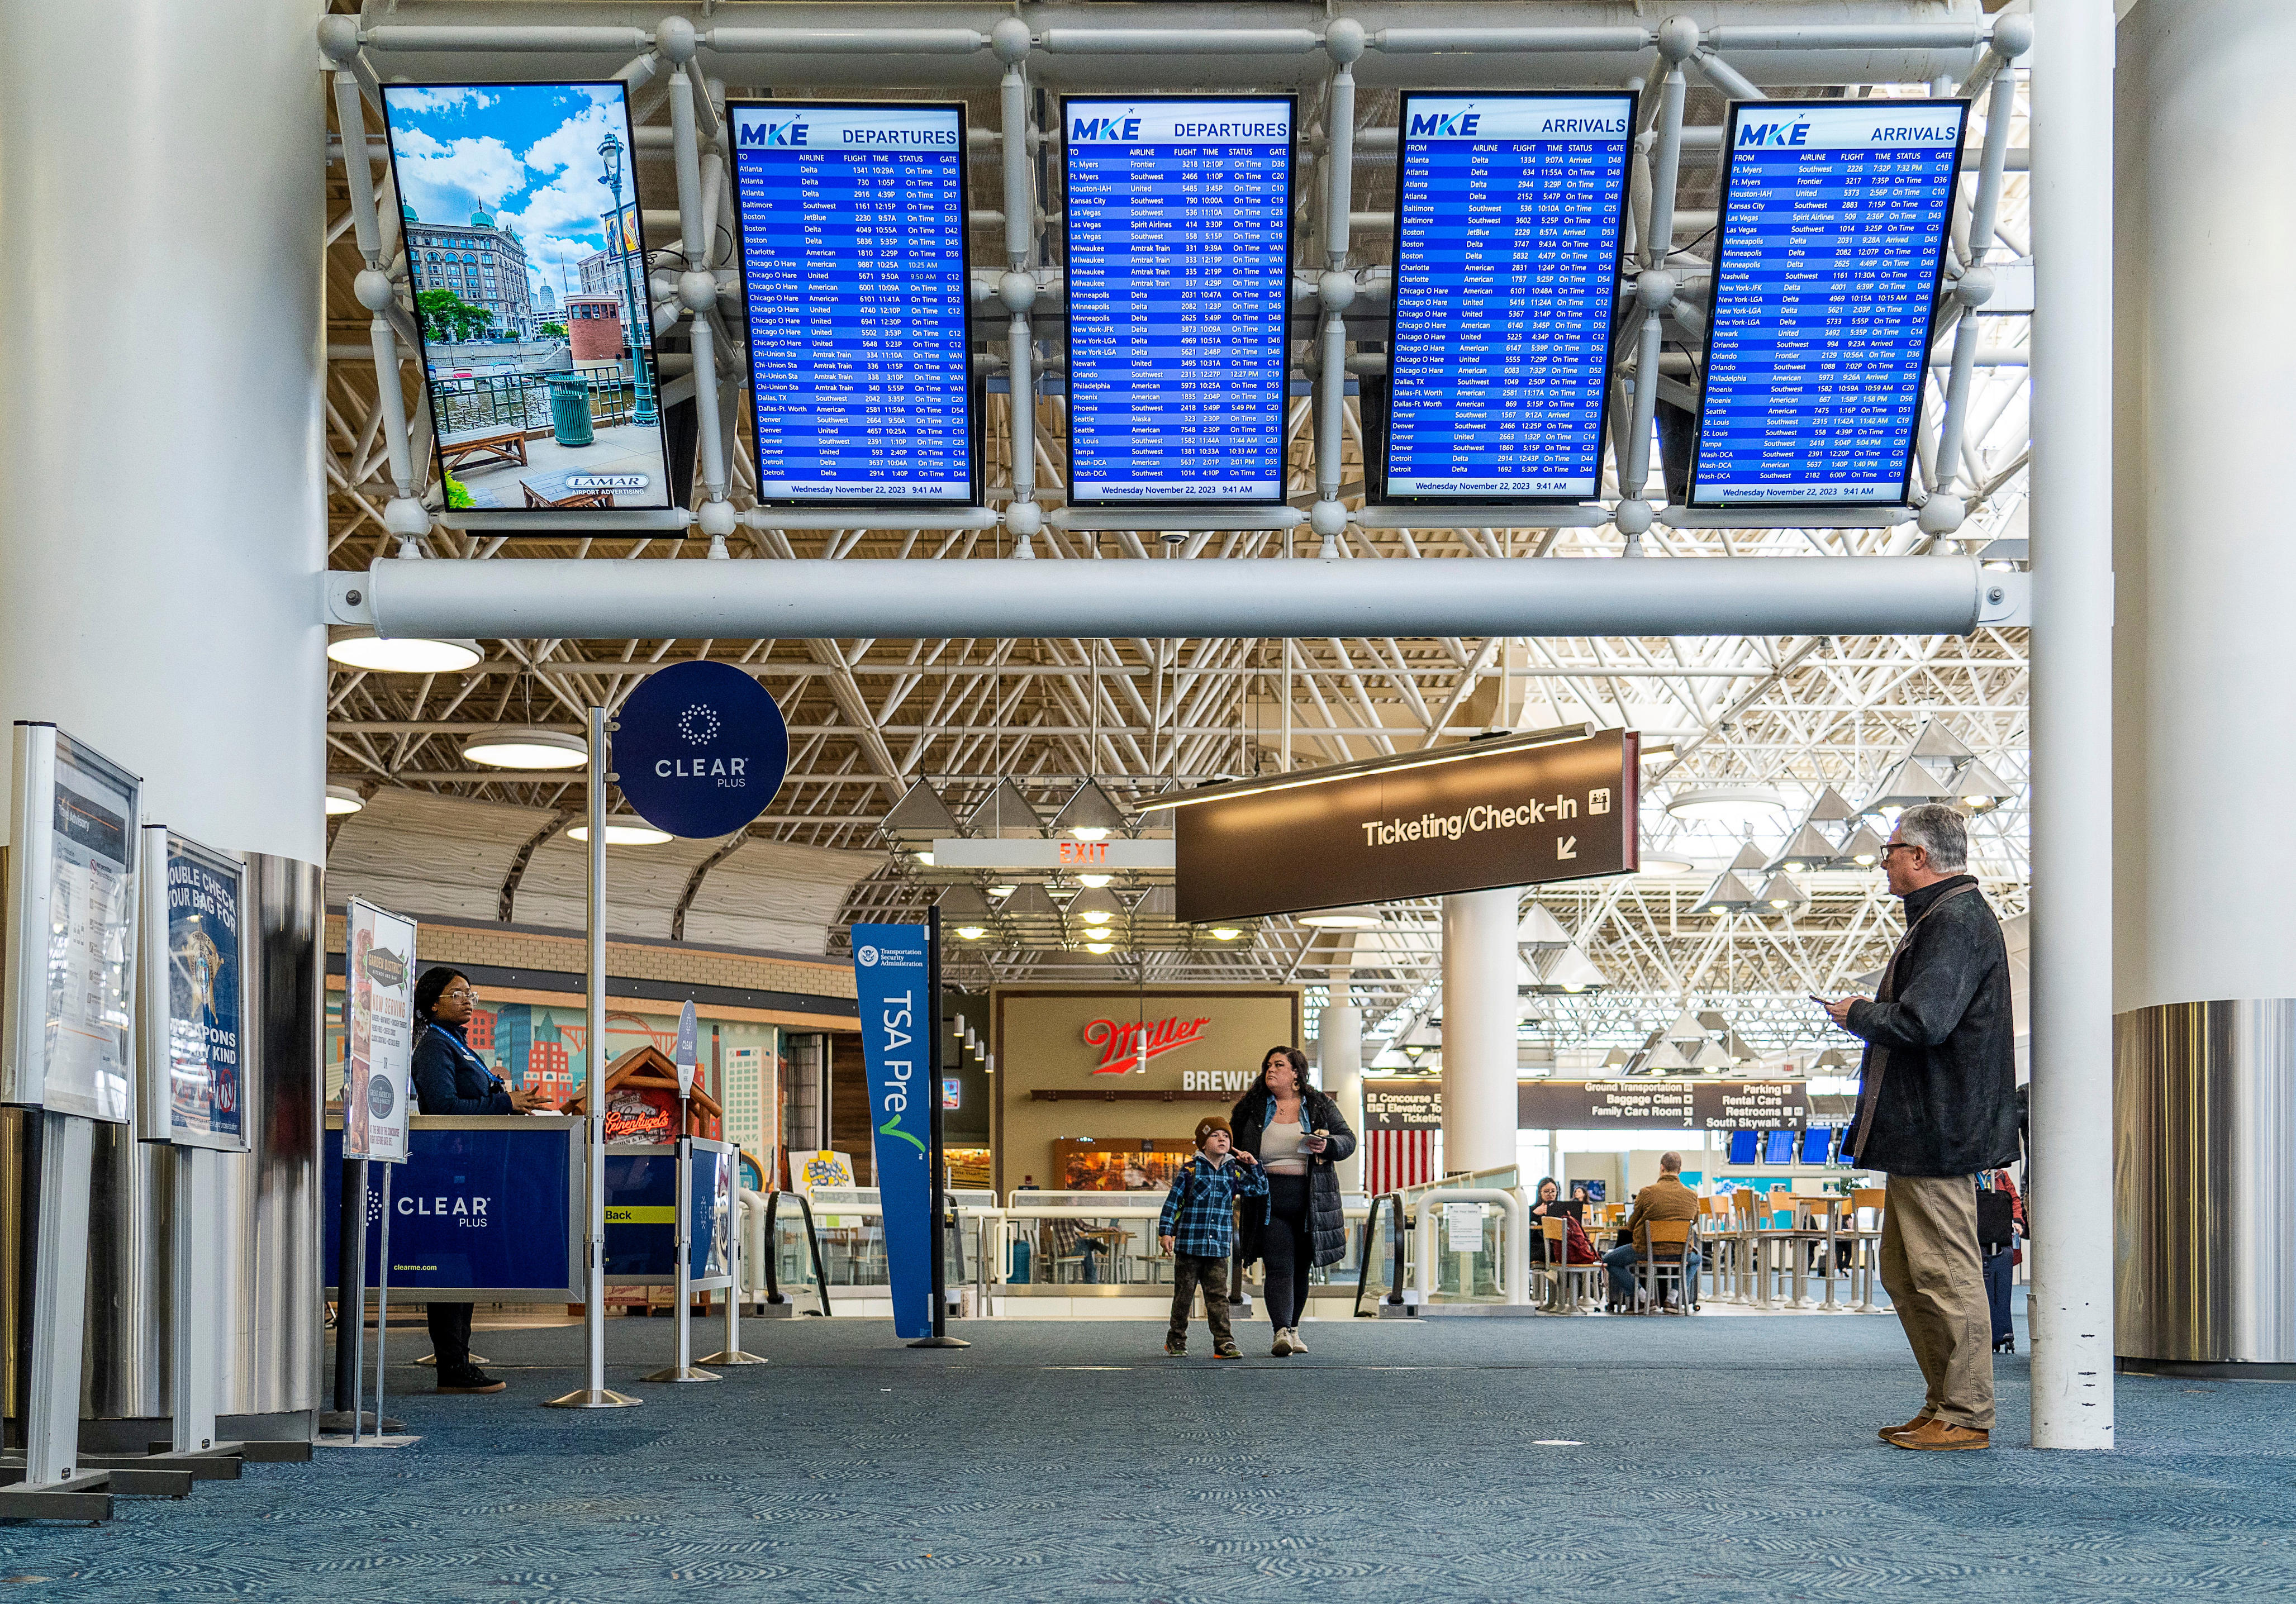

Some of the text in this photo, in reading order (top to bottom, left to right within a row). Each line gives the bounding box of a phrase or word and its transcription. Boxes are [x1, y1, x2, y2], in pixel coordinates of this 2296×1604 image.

[1072, 118, 1141, 140] MKE
[1175, 123, 1286, 136] DEPARTURES
[1410, 114, 1480, 136] MKE
[1542, 119, 1625, 132] ARRIVALS
[740, 123, 809, 145] MKE
[843, 130, 956, 144] DEPARTURES
[1739, 124, 1810, 145] MKE
[1871, 127, 1955, 140] ARRIVALS
[791, 486, 833, 495] Wednesday
[876, 486, 886, 494] 22,
[1102, 486, 1143, 495] Wednesday
[1186, 486, 1196, 494] 22,
[1416, 483, 1457, 491] Wednesday
[1500, 483, 1510, 491] 22,
[1807, 488, 1817, 497] 22,
[655, 758, 745, 777] CLEAR
[718, 779, 745, 787] PLUS
[70, 811, 89, 832] Advisory
[1362, 794, 1577, 846] Ticketing/Check-In
[1060, 843, 1109, 863] EXIT
[168, 867, 236, 916] OUBLE CHECK
[193, 889, 215, 915] BAG
[217, 902, 235, 937] FOR
[369, 954, 403, 975] GARDEN DISTRICT
[373, 994, 405, 1018] NOW SERVING
[883, 990, 912, 1051] TSA
[682, 1040, 692, 1050] CLEAR
[1084, 1016, 1211, 1067] Miller
[213, 1046, 235, 1064] KIND
[885, 1061, 912, 1112] Pre
[1183, 1070, 1257, 1091] BREWH
[1585, 1083, 1682, 1093] Ground Transportation
[1743, 1084, 1781, 1096] Parking
[1380, 1093, 1431, 1103] Concourse
[1607, 1094, 1682, 1106] Baggage Claim
[1723, 1096, 1781, 1105] Rental Cars
[1387, 1103, 1427, 1112] Elevator
[1592, 1106, 1682, 1117] Family Care Room
[1726, 1107, 1781, 1116] Restrooms
[1706, 1118, 1780, 1129] South Skywalk
[398, 1198, 487, 1215] CLEAR
[606, 1210, 631, 1220] Back
[459, 1218, 487, 1227] PLUS
